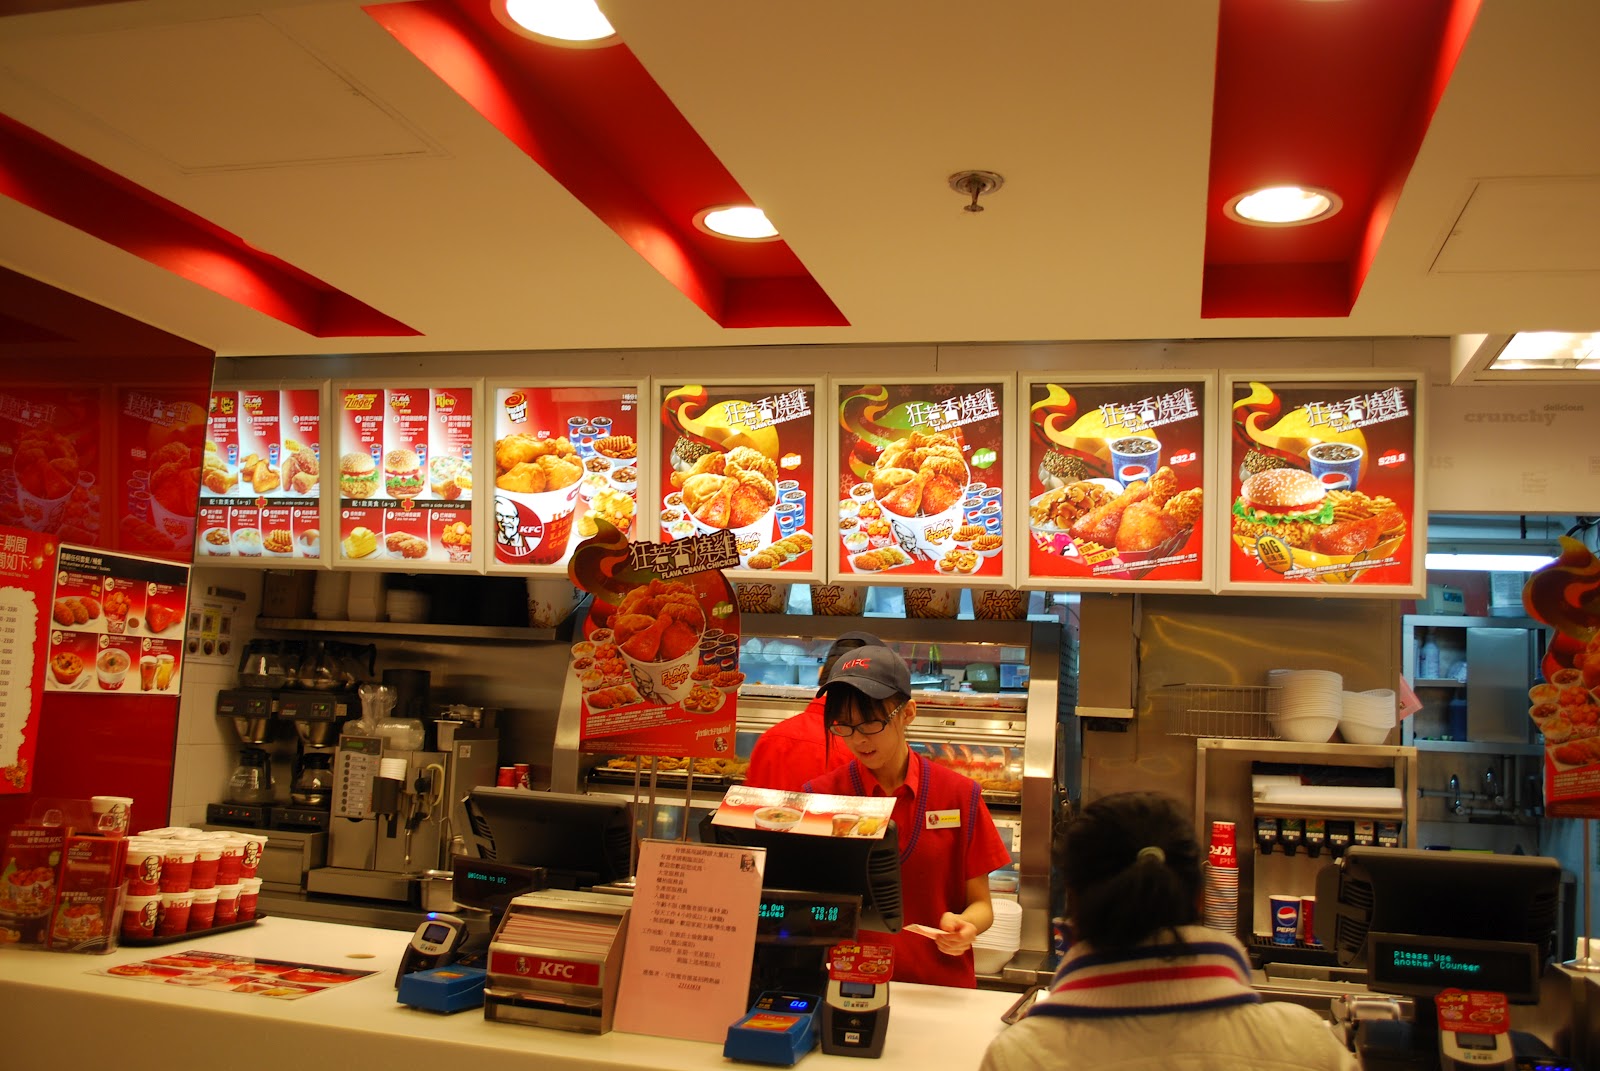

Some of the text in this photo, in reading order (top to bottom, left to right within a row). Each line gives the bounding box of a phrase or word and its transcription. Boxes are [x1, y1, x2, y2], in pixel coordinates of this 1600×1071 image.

[724, 388, 810, 426] 狂惹香燒雞
[905, 388, 997, 428] 狂惹香燒雞
[1099, 388, 1197, 428] 狂惹香燒雞
[1304, 386, 1406, 428] 狂惹香燒雞
[1544, 404, 1584, 412] delicious
[786, 409, 811, 421] CHICKEN
[973, 410, 999, 423] CHICKEN
[1170, 410, 1198, 423] CHICKEN
[1378, 410, 1409, 424] CHICKEN
[1464, 410, 1556, 427] crunchy
[971, 452, 997, 466] $148
[1170, 452, 1196, 465] $32.8
[1378, 453, 1406, 466] $29.8
[629, 530, 737, 573] 狂惹香燒雞
[1259, 540, 1281, 556] BIG
[662, 557, 738, 580] FLAVA CRAVA CHICKEN
[904, 588, 932, 599] LAVA
[983, 590, 1020, 600] FLAVA
[712, 604, 734, 617] $148
[984, 600, 1020, 612] ROAST
[842, 658, 872, 670] KFC
[662, 664, 689, 682] FLAVA
[1210, 845, 1233, 856] KFC
[163, 855, 183, 863] hot
[771, 903, 784, 912] Out
[1394, 950, 1452, 962] Please Use
[537, 962, 575, 978] KFC
[1394, 959, 1480, 971] Another Counter
